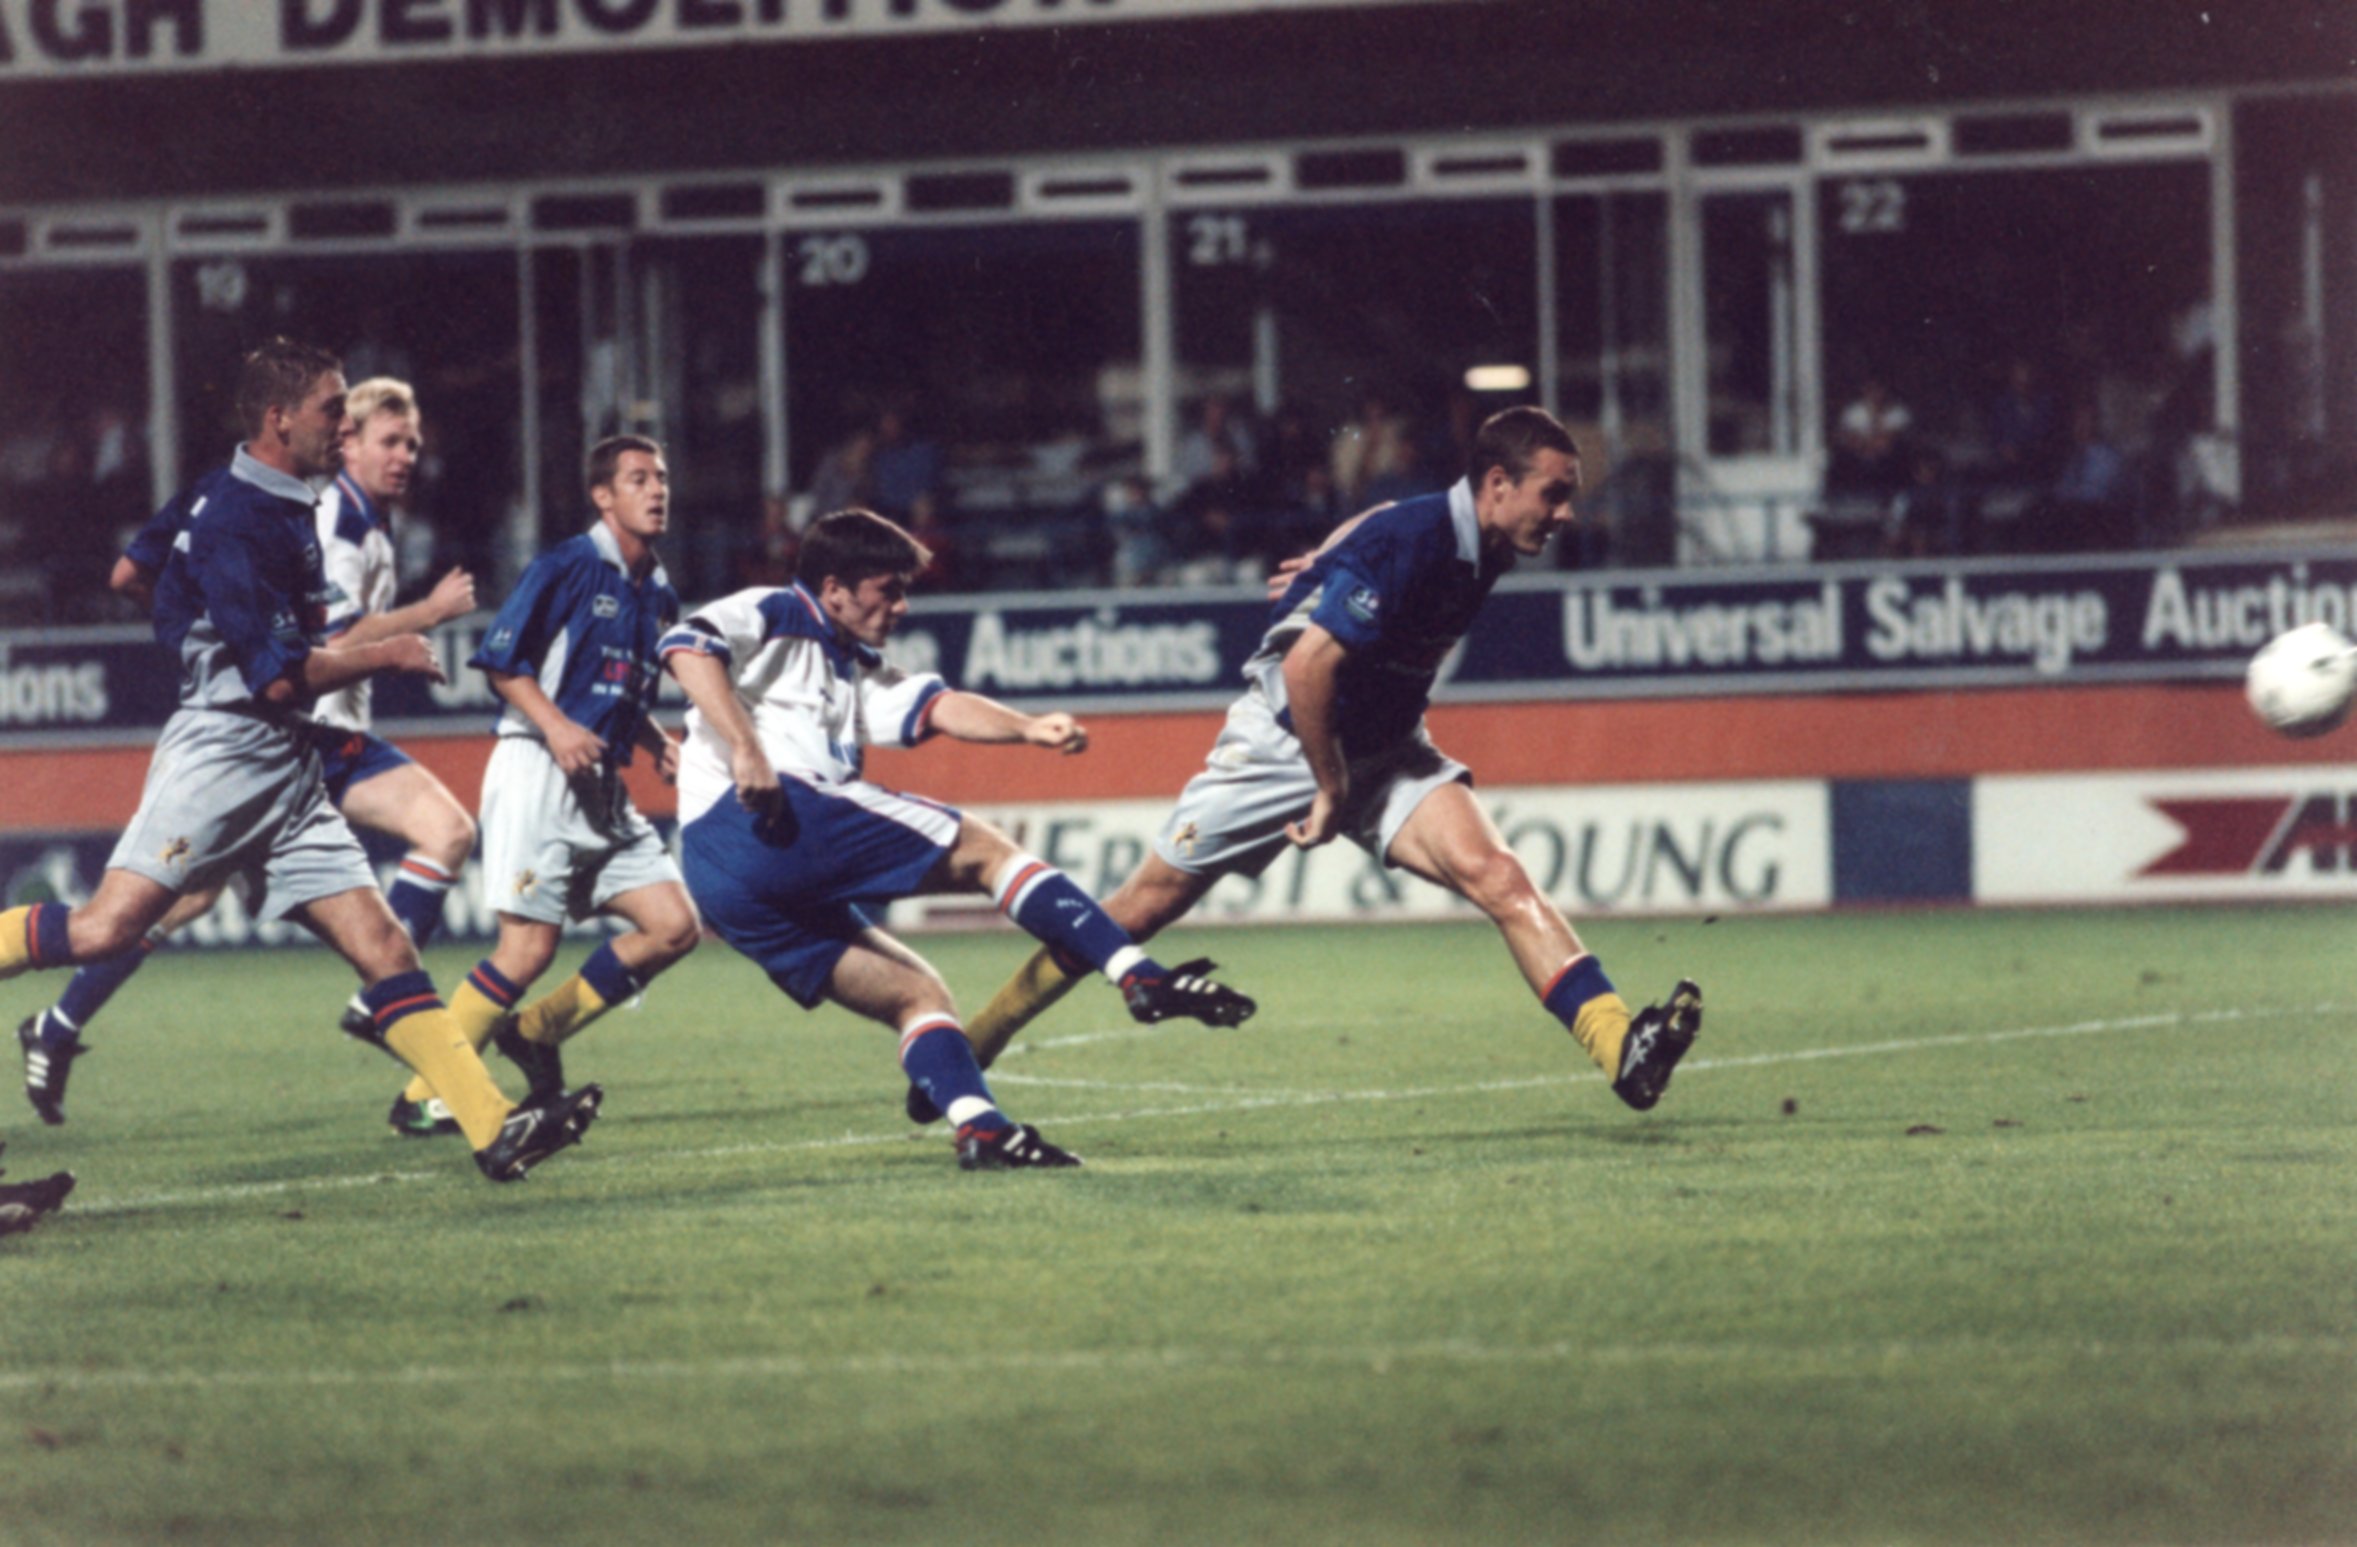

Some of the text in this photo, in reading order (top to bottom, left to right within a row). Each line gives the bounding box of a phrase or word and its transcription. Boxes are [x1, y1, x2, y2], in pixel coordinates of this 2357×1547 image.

[1842, 184, 1906, 232] 22
[799, 236, 869, 284] 20
[962, 602, 1222, 690] Auctions
[1563, 562, 2357, 675] Universal Salvage Auctio
[1494, 810, 1786, 905] OUNG
